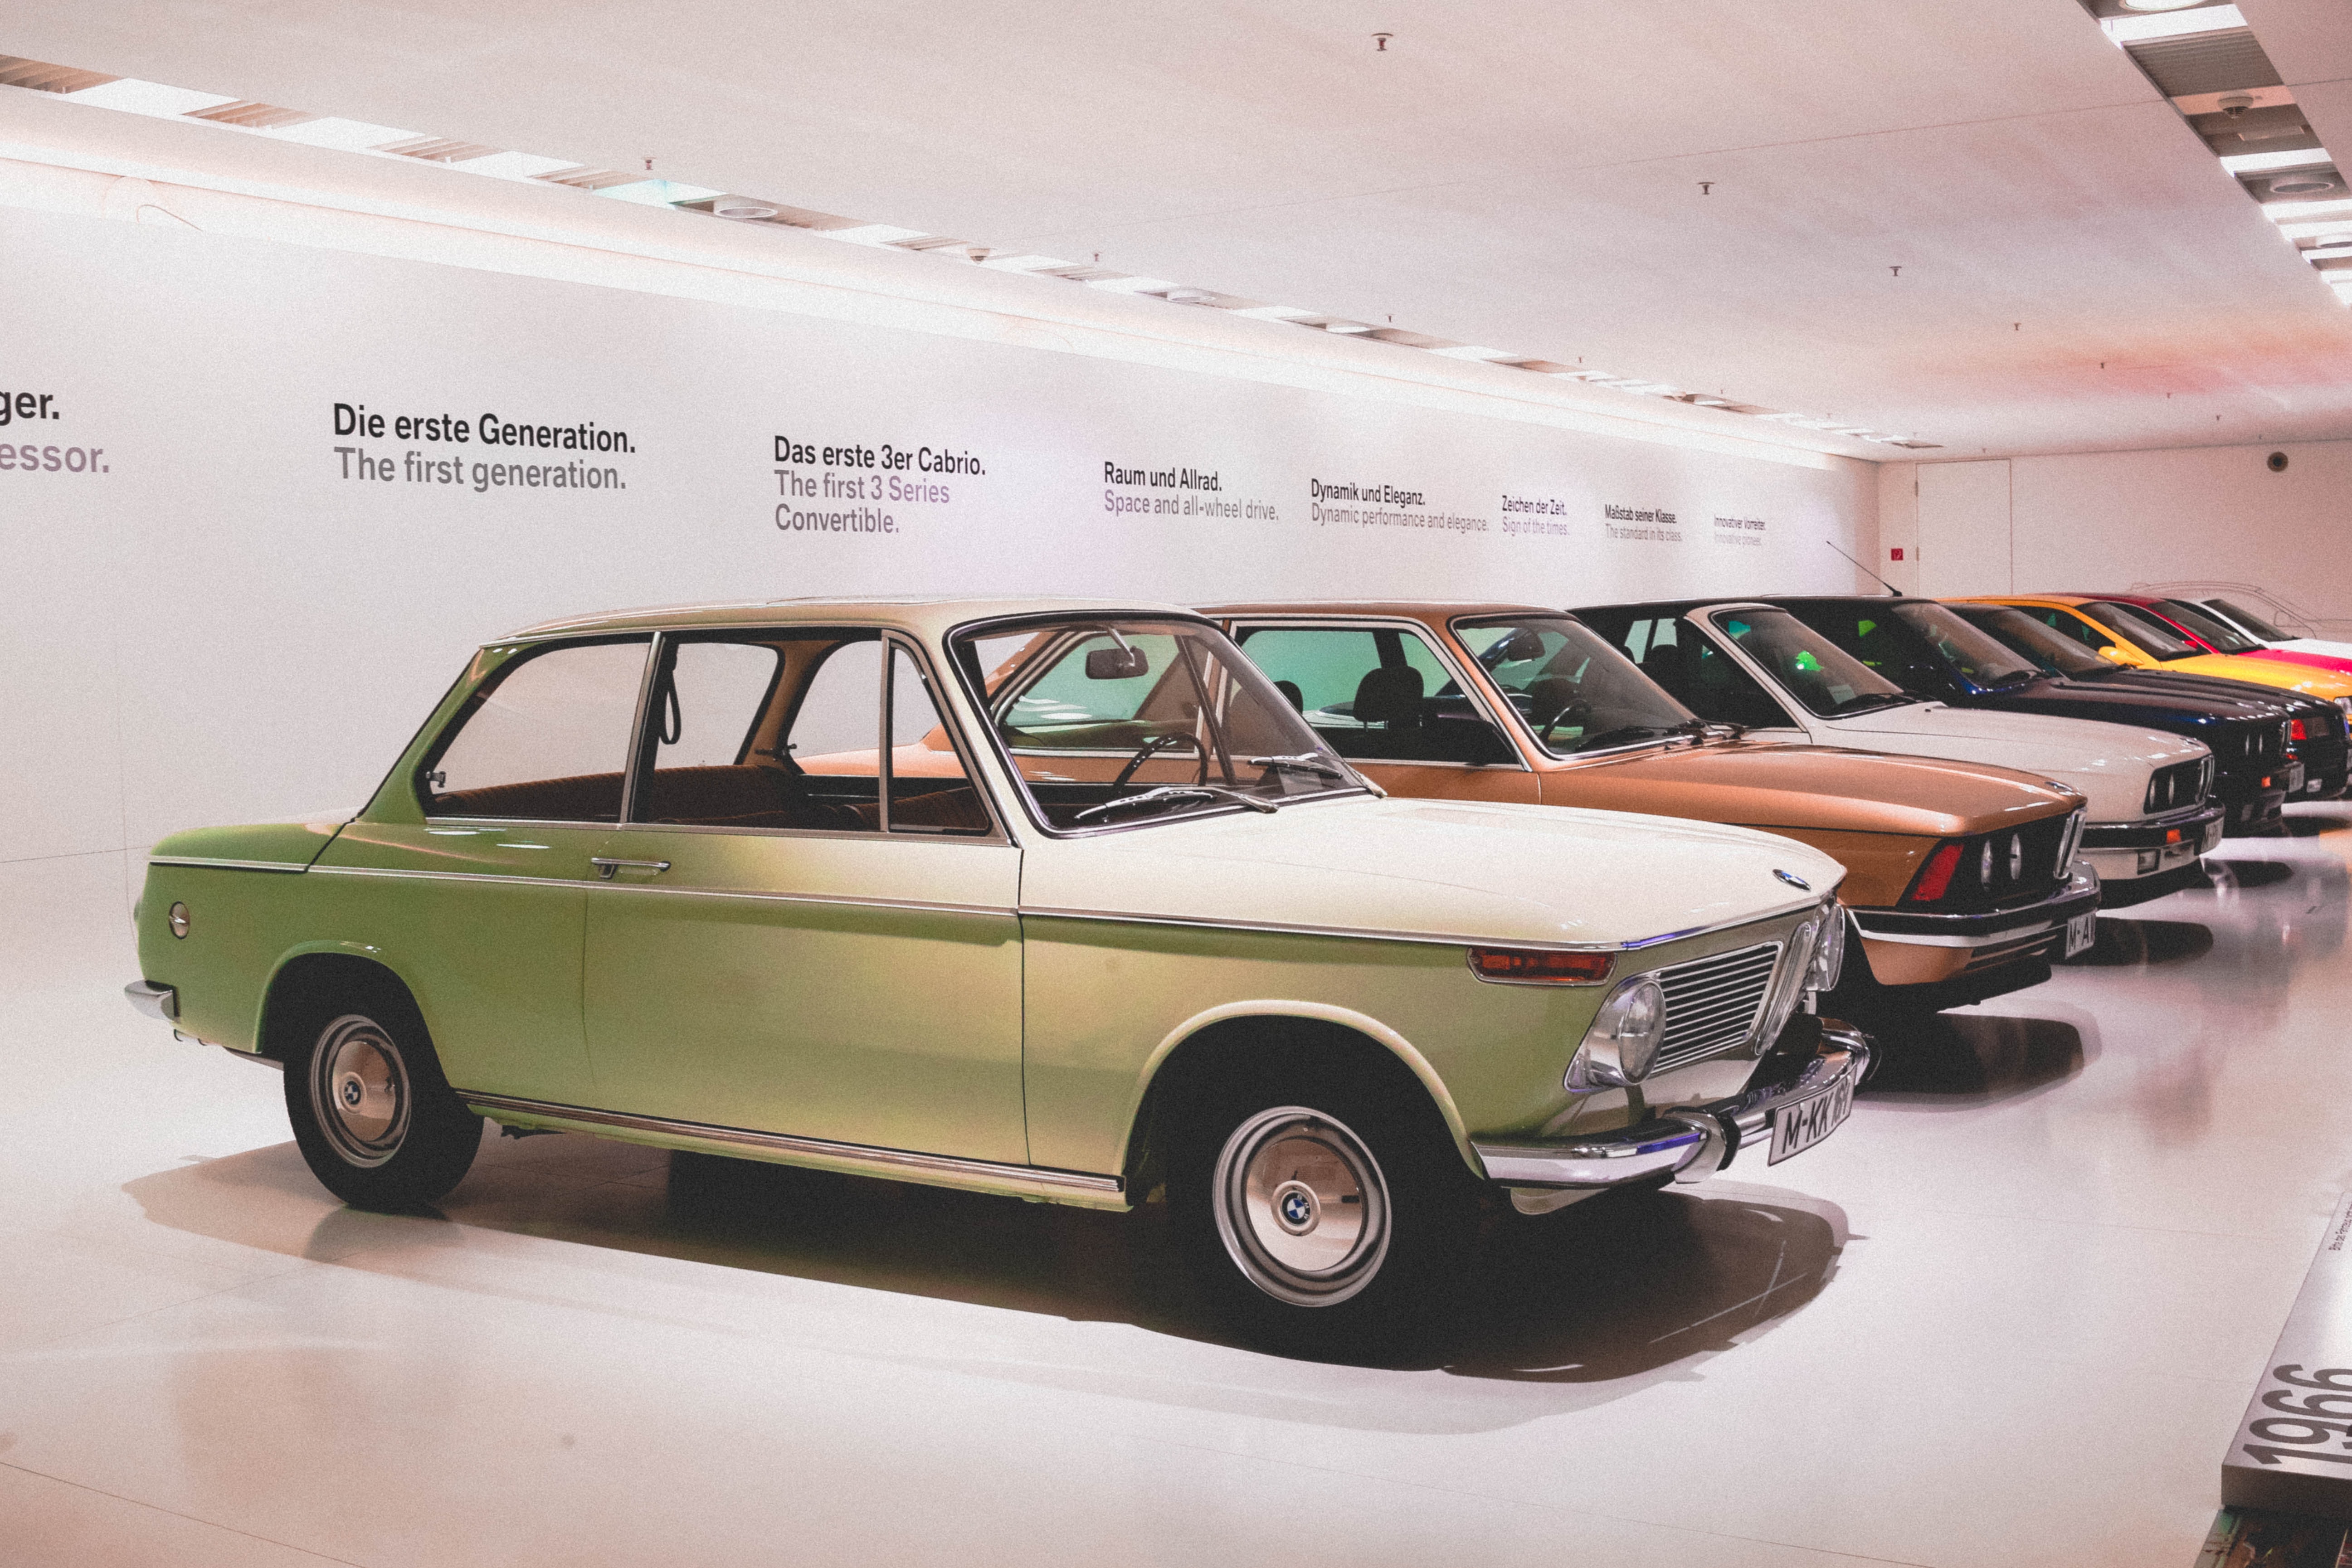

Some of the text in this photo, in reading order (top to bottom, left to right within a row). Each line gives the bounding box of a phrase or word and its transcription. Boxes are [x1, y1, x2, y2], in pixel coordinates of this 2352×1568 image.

[334, 403, 635, 453] Die erste Generation.
[334, 447, 626, 492] The first generation.
[774, 435, 986, 475] Das erste 3er Cabrio.
[774, 470, 950, 503] The first 3 Series
[1105, 461, 1222, 491] Raum und Allrad.
[1105, 489, 1279, 521] Space and all-wheel drive.
[1311, 478, 1425, 508] Dynamik und Eleganz.
[1502, 495, 1567, 516] Zeichen der Zeit.
[775, 503, 899, 533] Convertible.
[1312, 502, 1489, 534] Dynamic performance and elegance.
[1502, 516, 1521, 536] Sign
[1523, 518, 1531, 533] of
[1533, 519, 1545, 534] the
[1635, 507, 1655, 522] seiner
[2243, 1364, 2352, 1465] 1966
